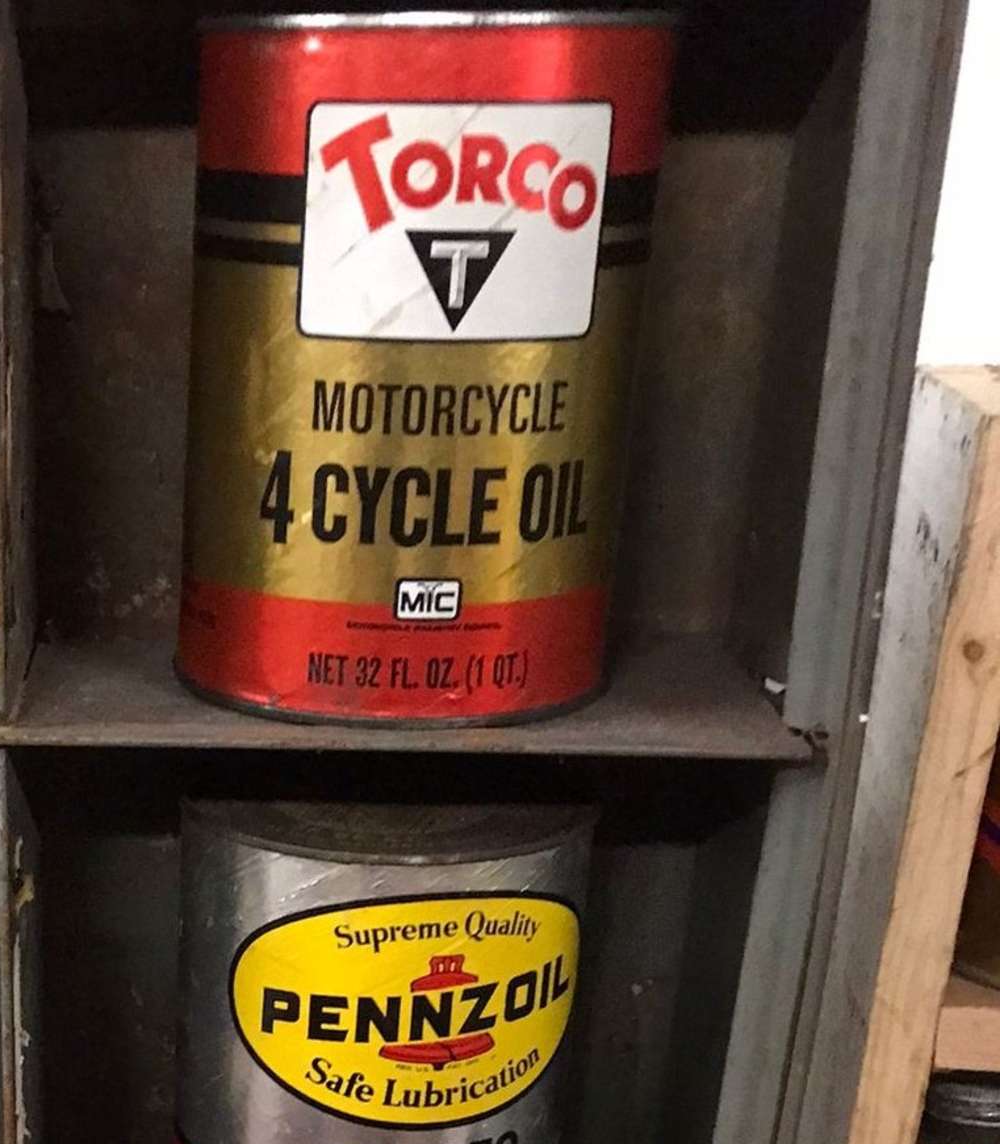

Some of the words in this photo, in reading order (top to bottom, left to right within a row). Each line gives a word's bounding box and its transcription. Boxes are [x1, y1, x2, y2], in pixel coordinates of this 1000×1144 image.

[320, 113, 598, 233] TORCO
[312, 379, 568, 437] MOTORCYCLE
[260, 450, 294, 544] 4
[311, 462, 506, 548] CYCLE
[519, 459, 588, 543] OIL
[400, 591, 455, 613] MIC
[307, 651, 350, 686] NET
[355, 655, 381, 689] 32
[390, 656, 420, 690] FL.
[426, 657, 459, 691] OZ.
[464, 653, 484, 693] (1
[493, 652, 529, 690] QT.)
[333, 919, 459, 953] Supreme
[464, 910, 541, 943] Quality
[260, 953, 570, 1044] PENNZOIL
[304, 1057, 375, 1103] Safe
[382, 1047, 540, 1108] Lubrication
